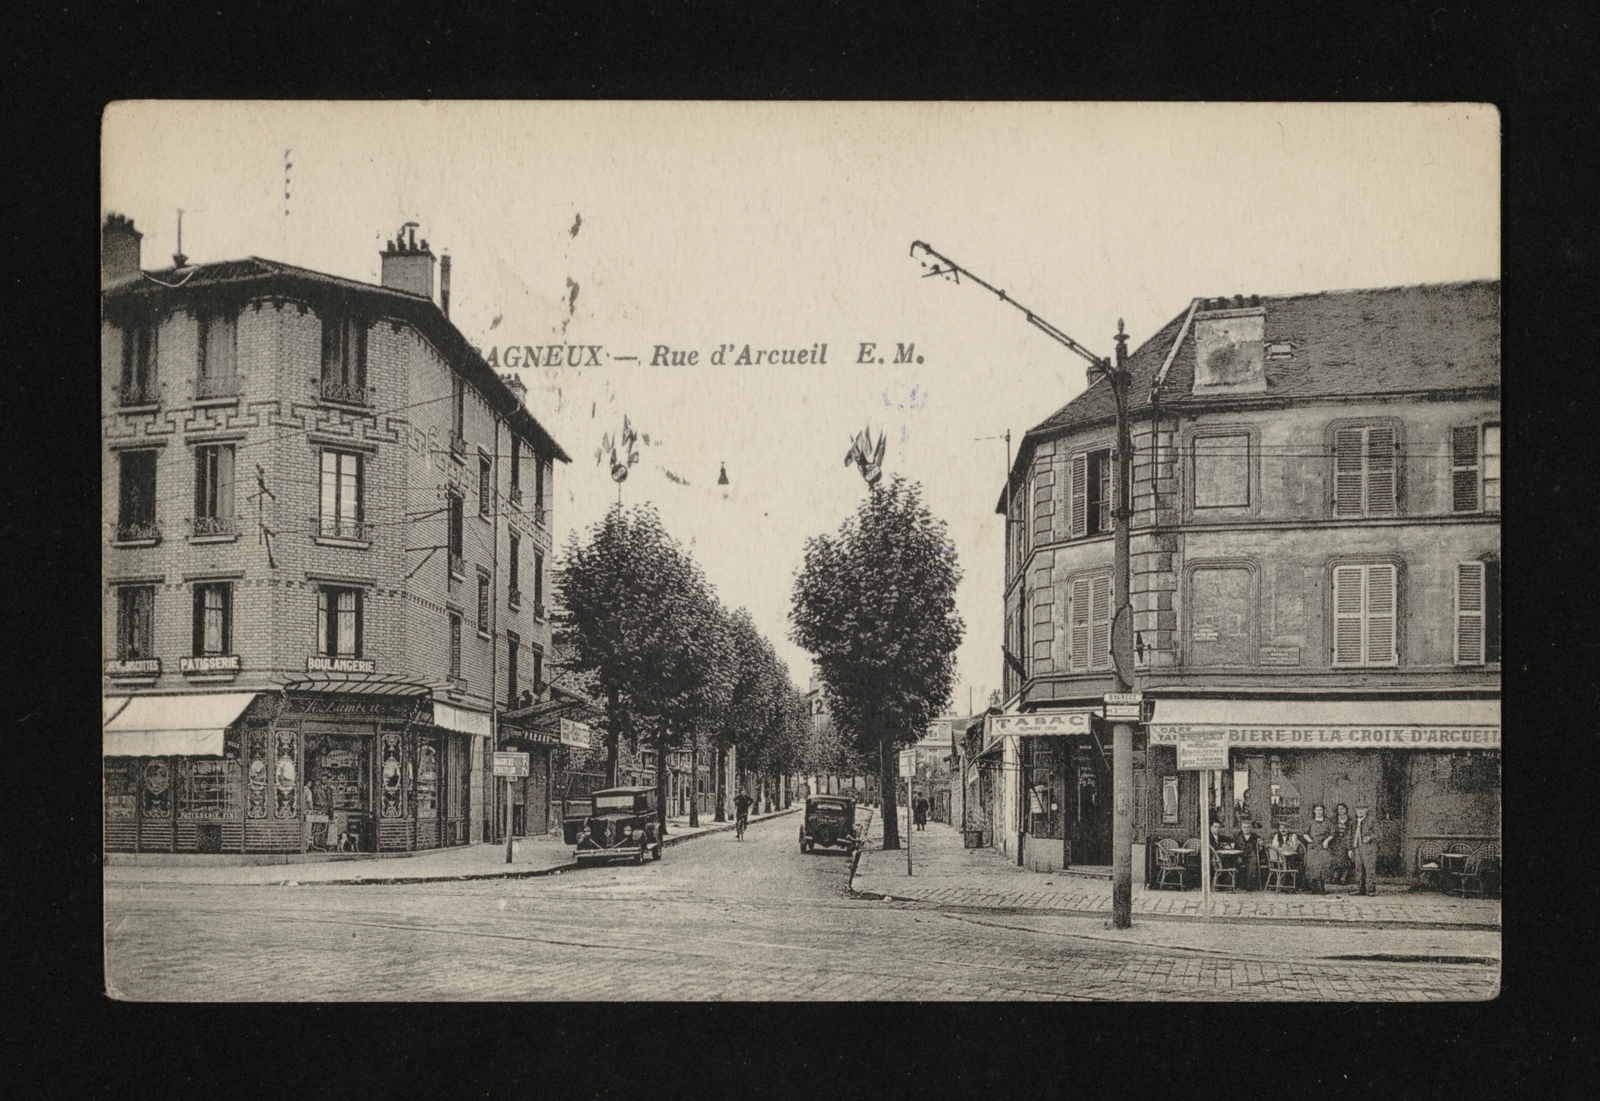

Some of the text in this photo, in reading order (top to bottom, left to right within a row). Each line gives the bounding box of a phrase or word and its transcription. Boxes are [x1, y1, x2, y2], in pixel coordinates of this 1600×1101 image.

[180, 656, 239, 671] PATISSERIE
[307, 657, 375, 673] BOULANGERIE
[995, 716, 1084, 729] TABAC
[1229, 729, 1285, 742] BIERE
[1291, 729, 1314, 742] DE
[1317, 729, 1343, 742] LA
[1349, 729, 1405, 742] CROIX
[1410, 729, 1501, 743] D'ARCUEIL
